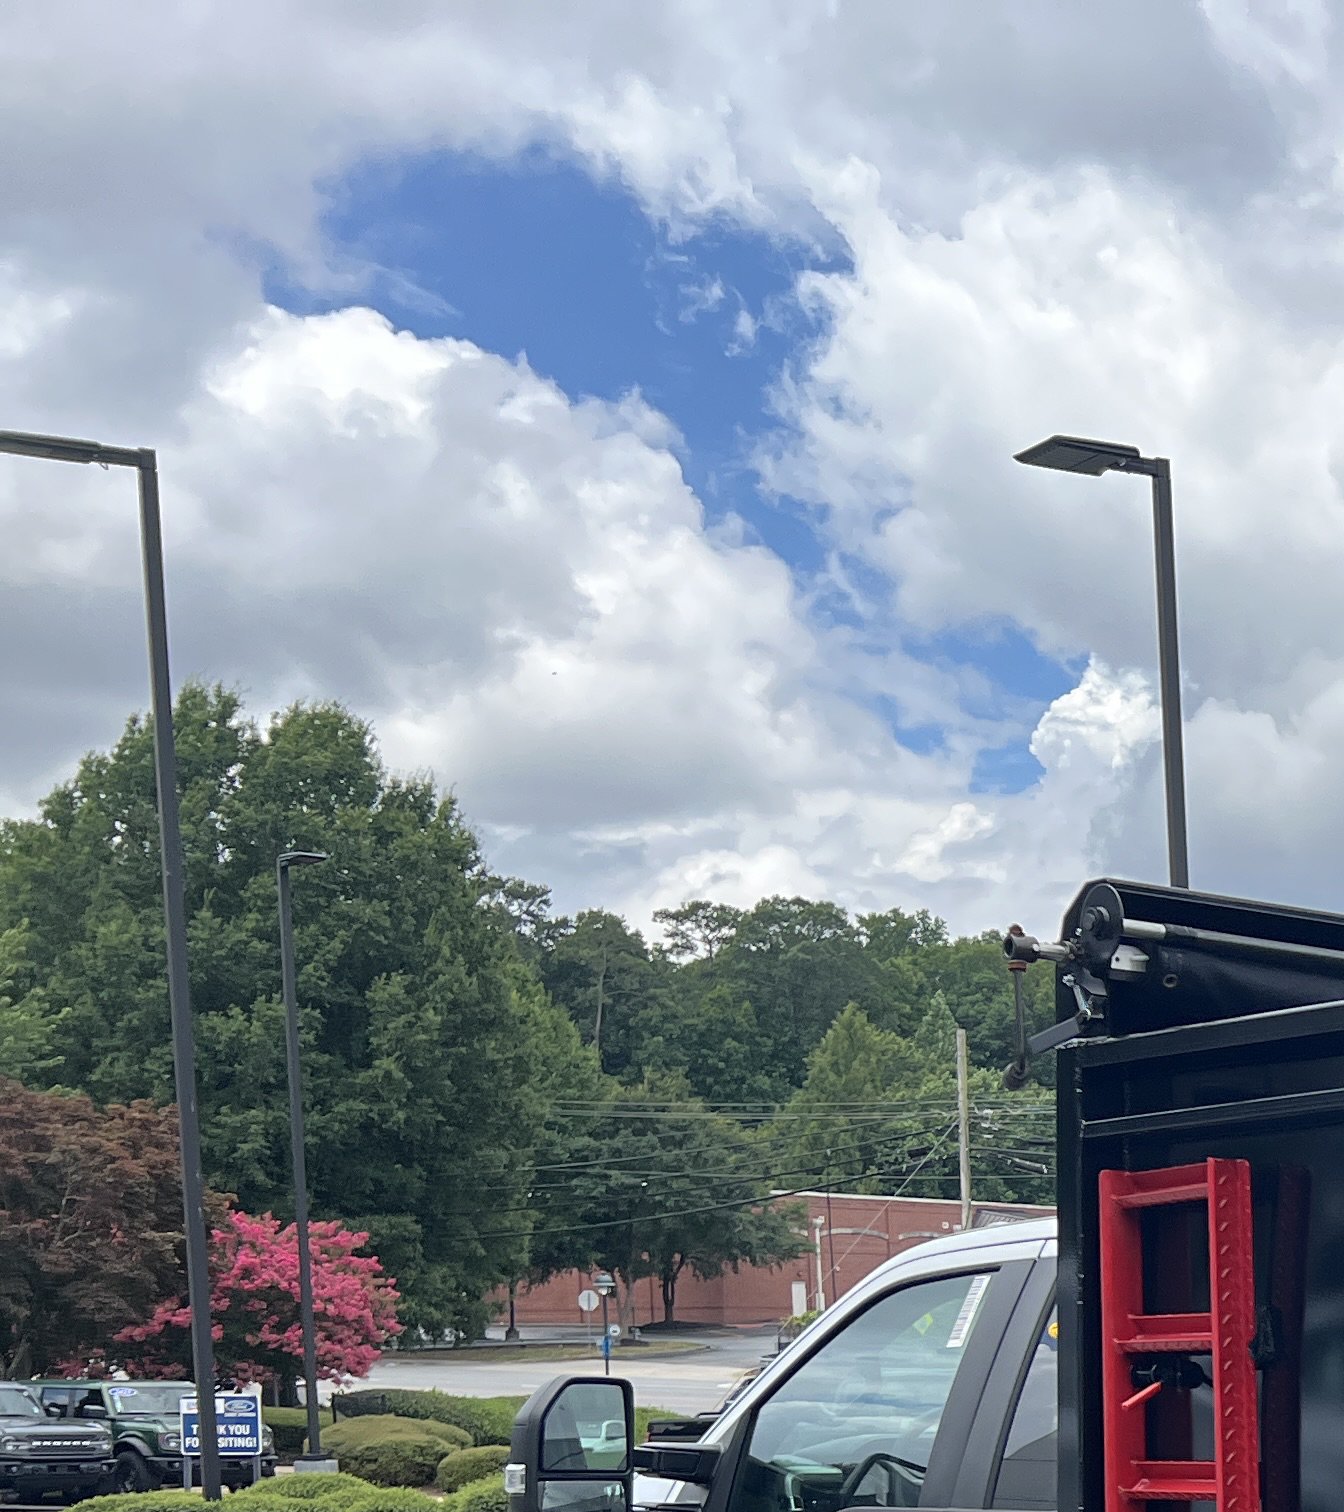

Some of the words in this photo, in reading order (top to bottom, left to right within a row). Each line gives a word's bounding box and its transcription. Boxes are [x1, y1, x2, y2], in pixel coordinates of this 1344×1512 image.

[228, 1425, 250, 1435] YOU
[185, 1437, 200, 1448] FO
[217, 1437, 257, 1448] SITING!
